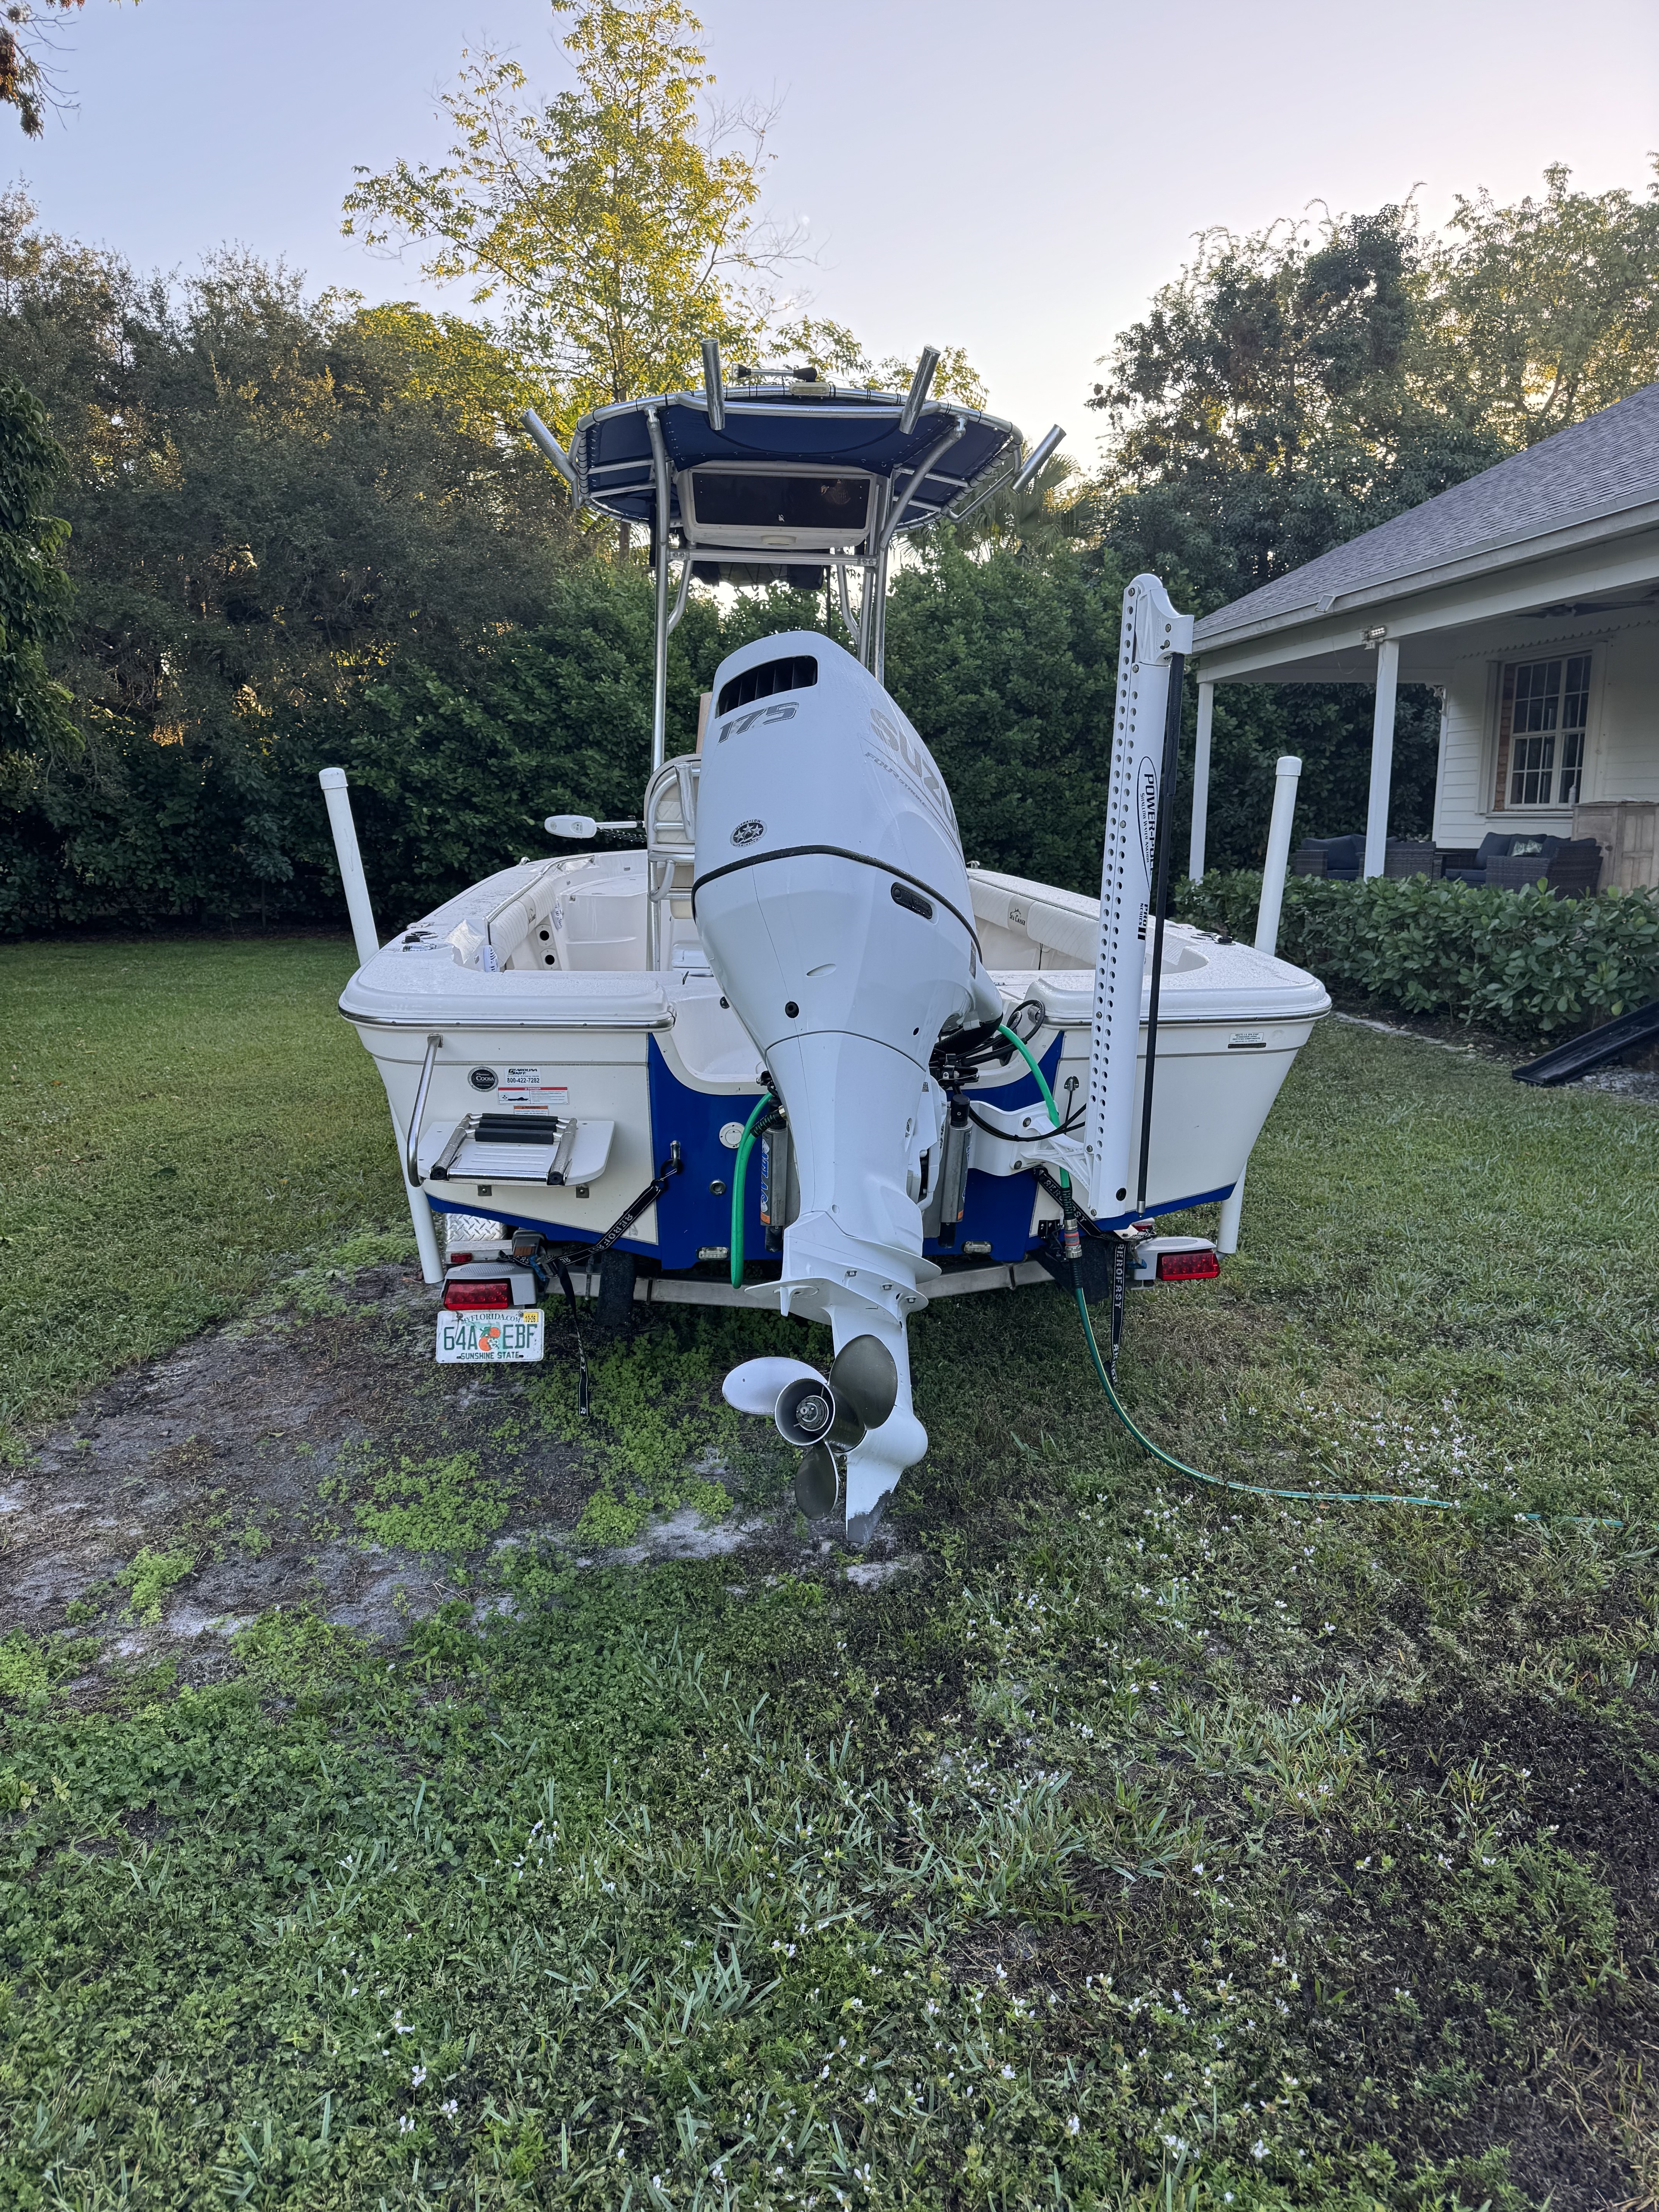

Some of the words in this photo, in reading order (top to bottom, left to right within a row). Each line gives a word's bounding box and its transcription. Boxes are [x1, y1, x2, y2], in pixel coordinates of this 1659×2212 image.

[717, 702, 799, 745] 175
[443, 1325, 477, 1350] 64A
[503, 1324, 538, 1349] EBF
